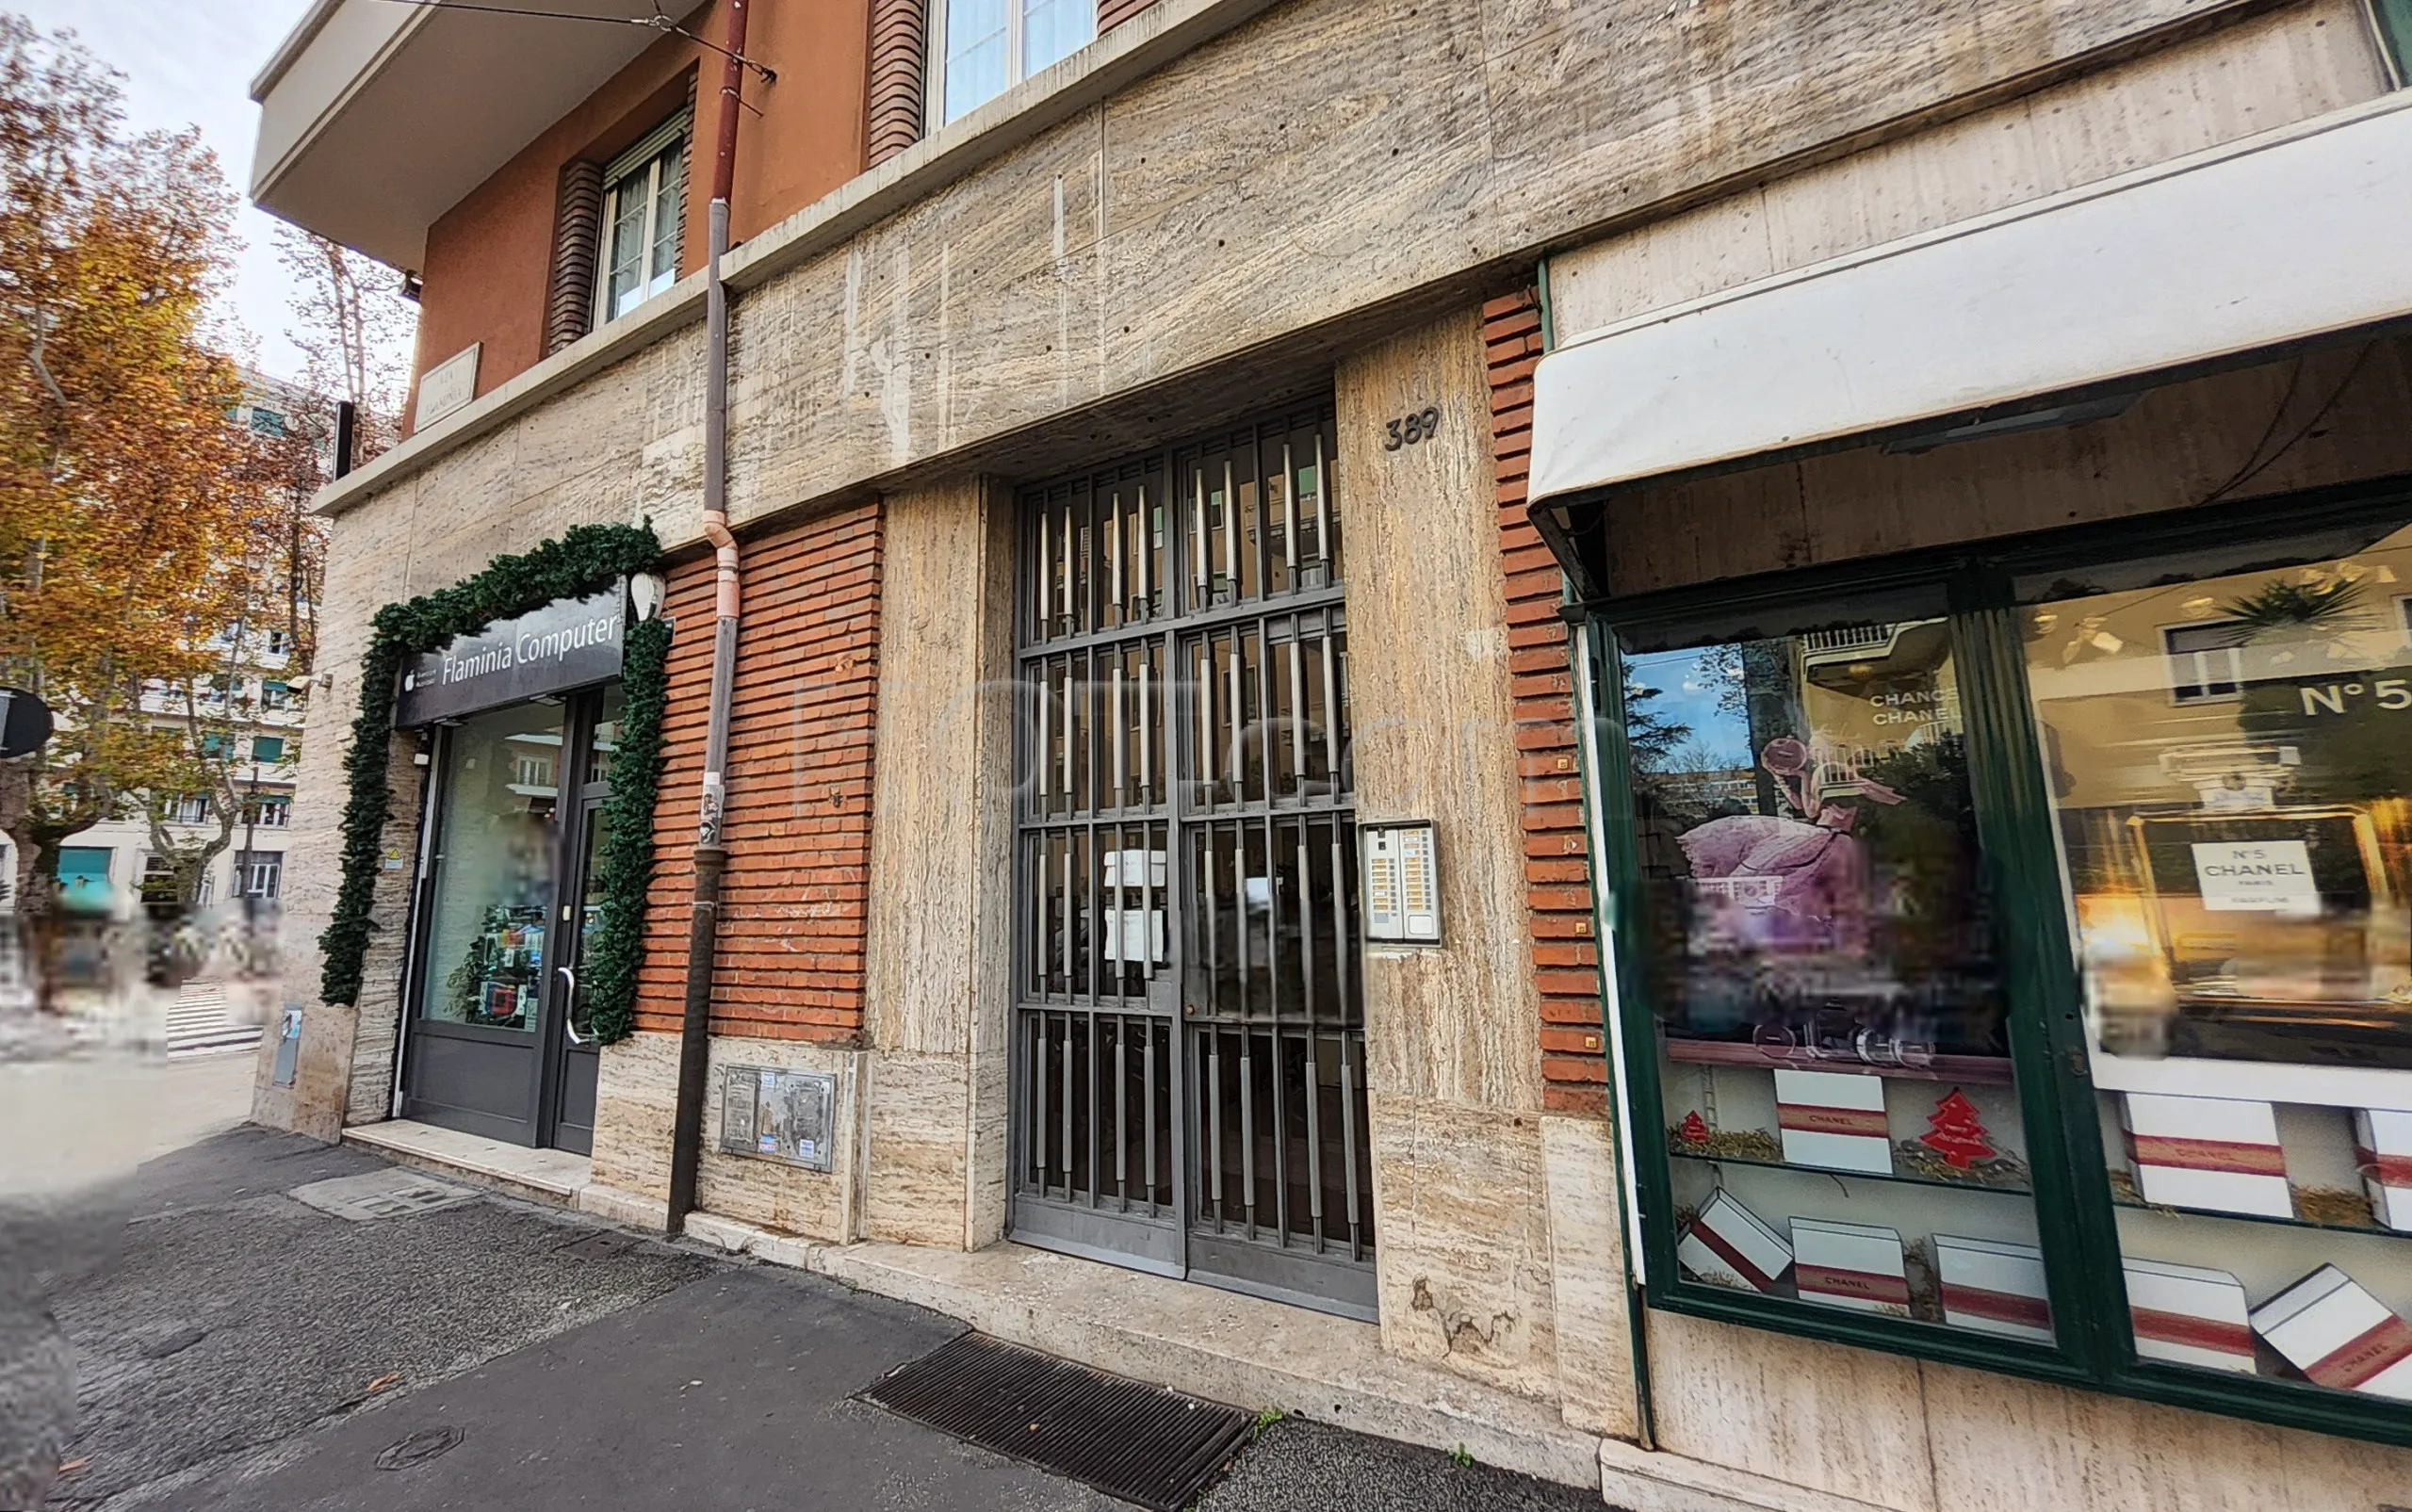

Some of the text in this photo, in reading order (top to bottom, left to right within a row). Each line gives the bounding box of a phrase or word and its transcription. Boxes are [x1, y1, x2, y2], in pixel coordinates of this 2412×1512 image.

[1384, 406, 1439, 452] 389
[442, 613, 618, 686] Flaminia Computer
[1872, 706, 1962, 725] CHANEL
[2204, 863, 2306, 876] CHANEL
[1809, 1114, 1854, 1126] CHANEL
[1825, 1276, 1870, 1291] CHANEL
[2341, 1341, 2388, 1373] CHANEL
